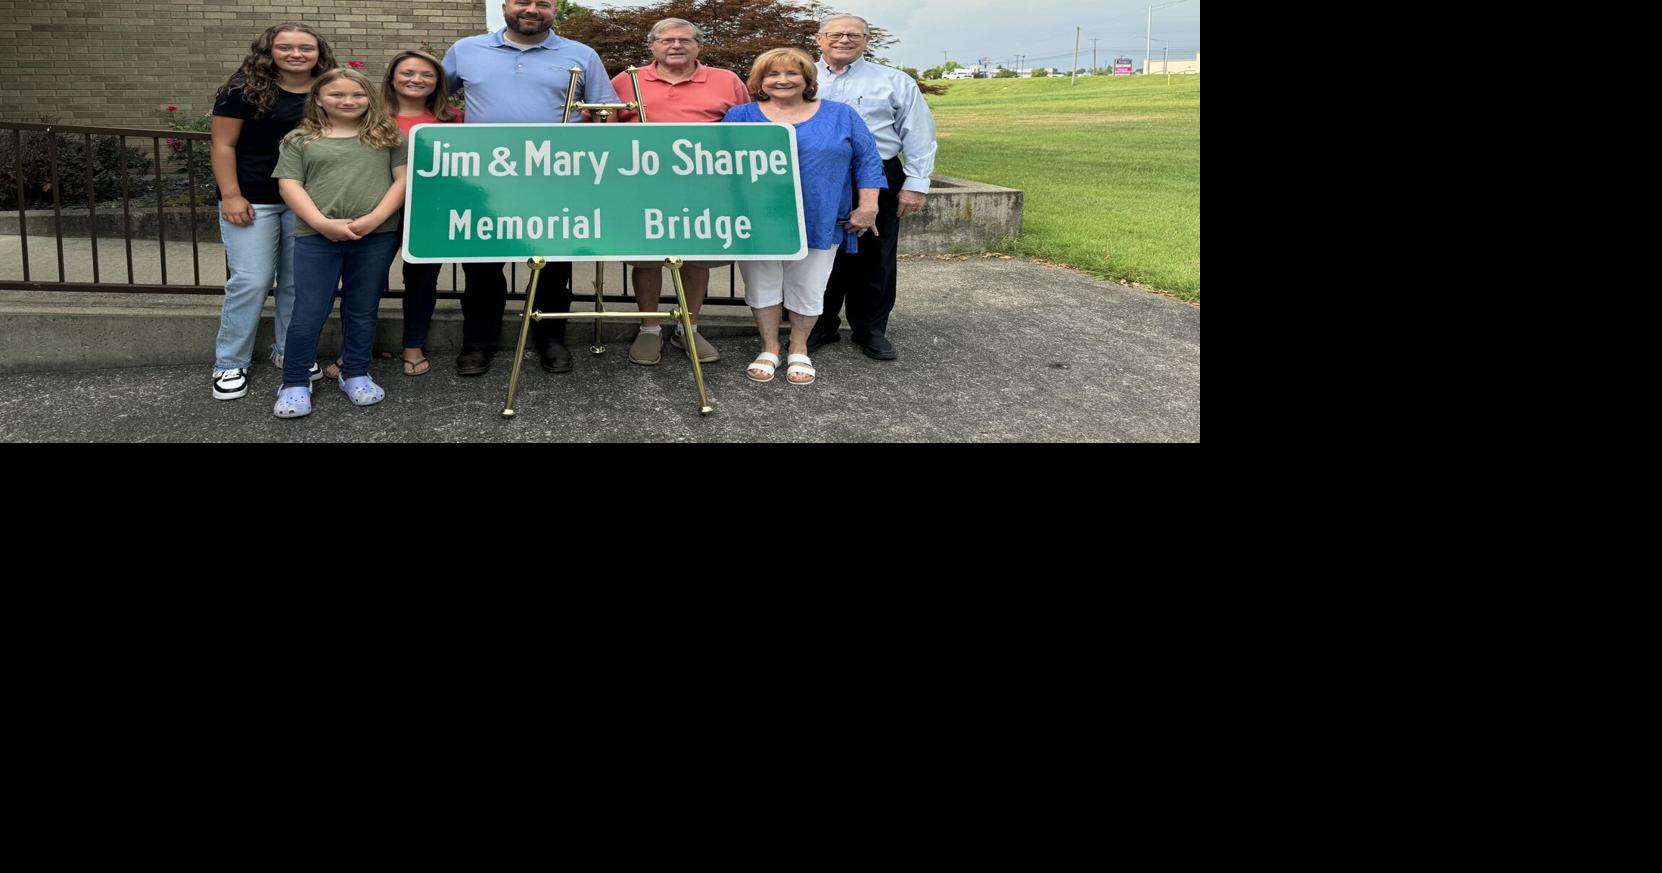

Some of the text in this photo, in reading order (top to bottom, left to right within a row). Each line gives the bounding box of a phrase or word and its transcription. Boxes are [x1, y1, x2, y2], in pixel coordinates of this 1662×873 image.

[416, 138, 788, 185] Jim & Mary Jo Sharpe
[448, 207, 753, 249] Memorial Bridge
